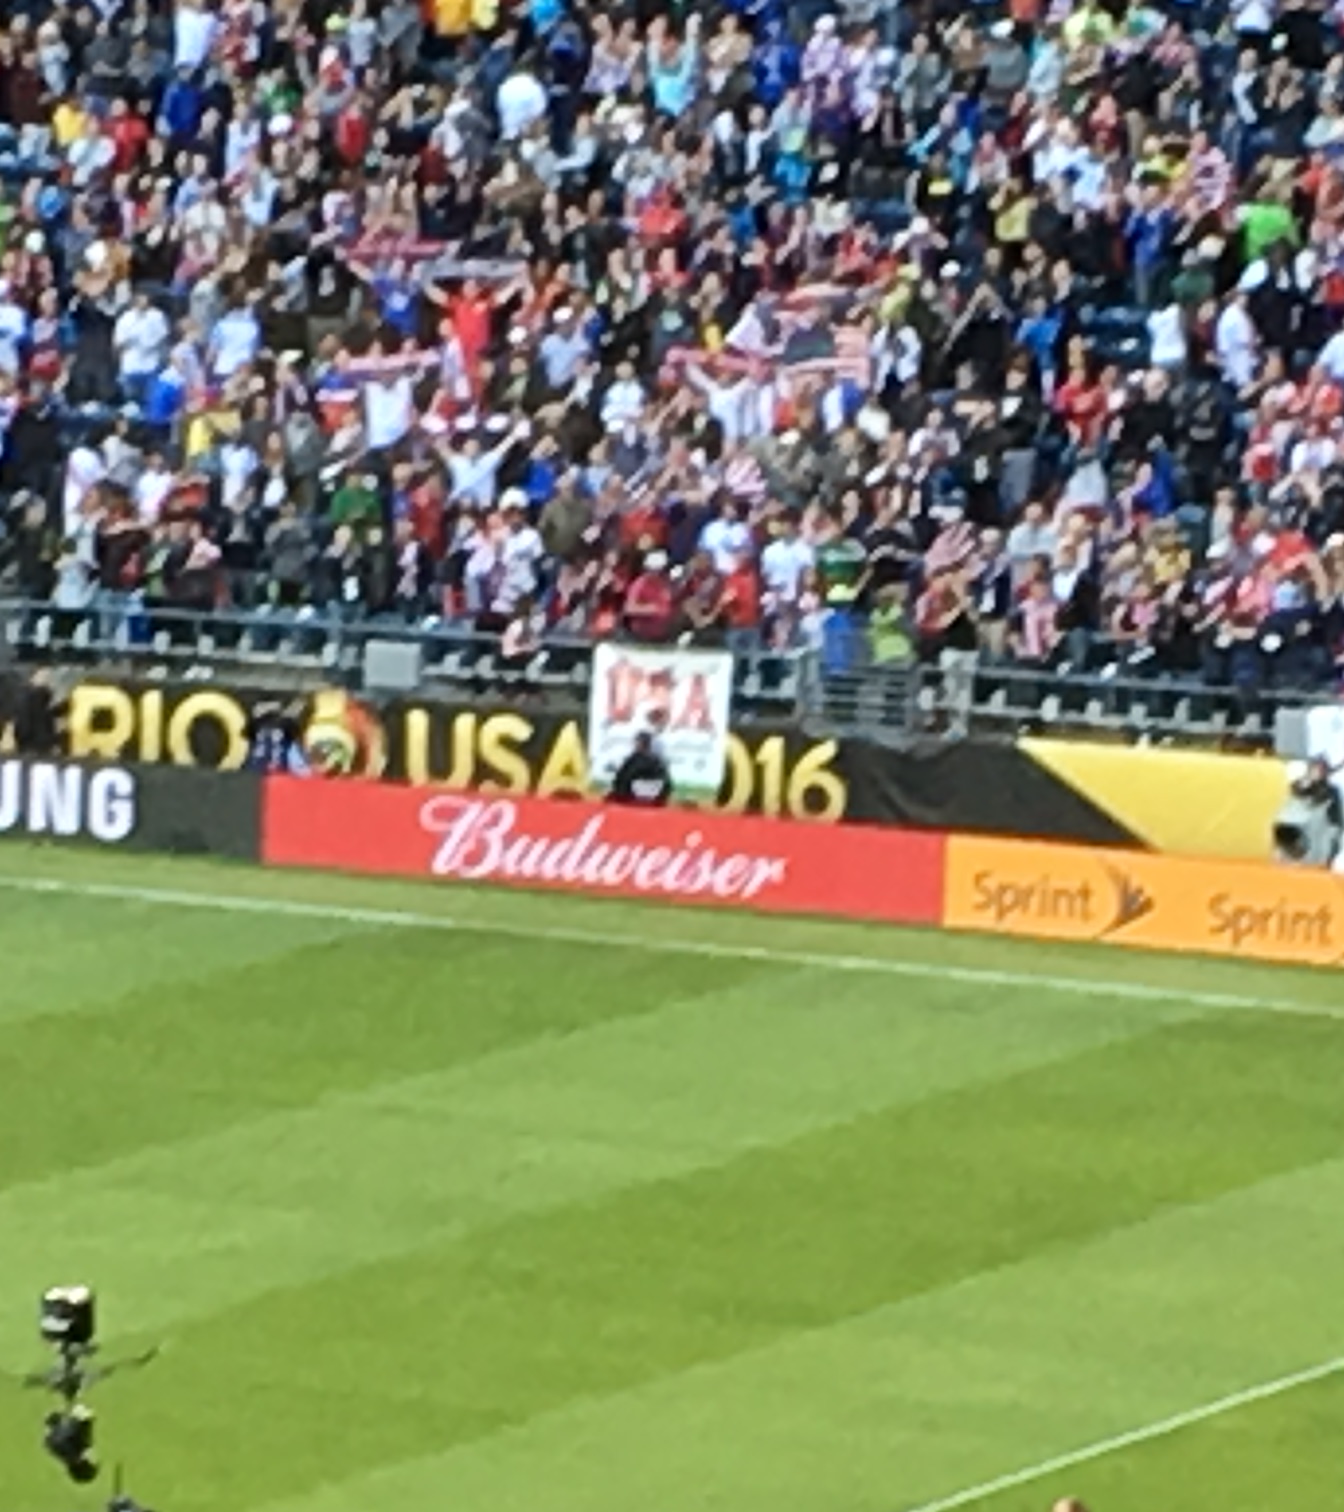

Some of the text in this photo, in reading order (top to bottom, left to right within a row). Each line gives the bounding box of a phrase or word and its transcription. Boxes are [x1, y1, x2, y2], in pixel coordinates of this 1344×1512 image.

[404, 708, 594, 801] USA
[694, 732, 848, 825] 016
[418, 794, 788, 899] Budweiser
[972, 870, 1094, 922] Sprint
[1207, 892, 1335, 946] Sprint
